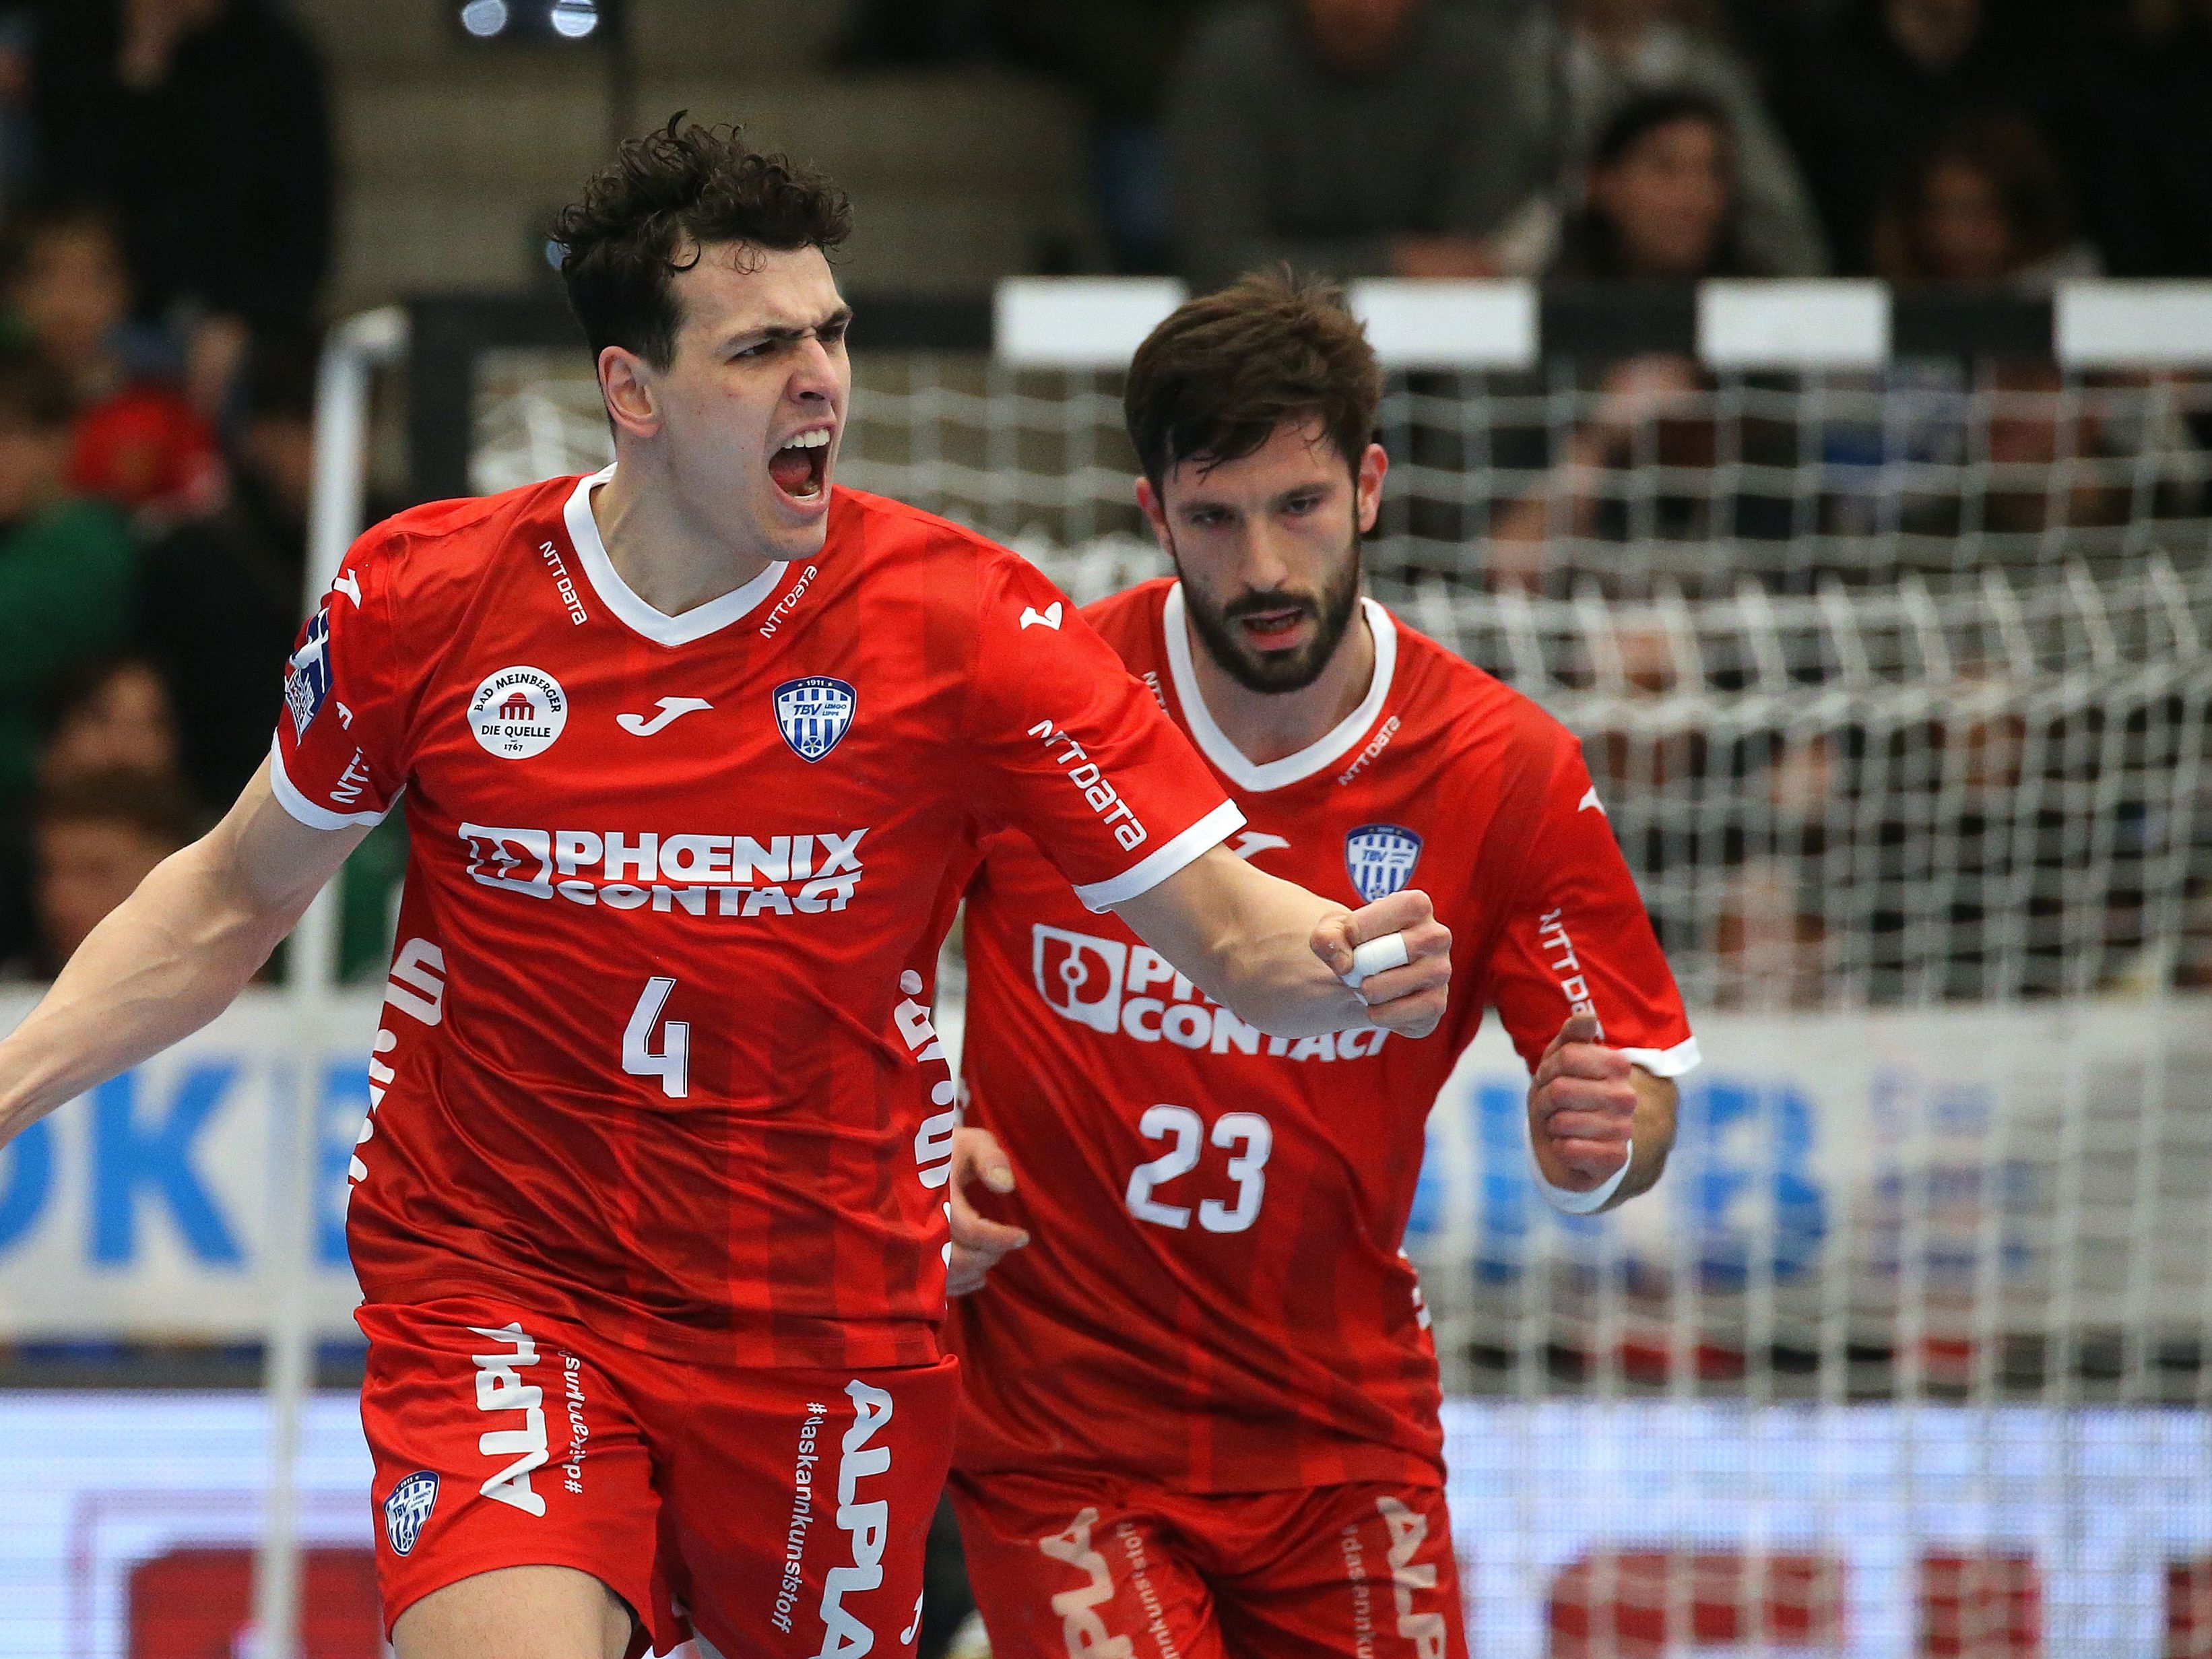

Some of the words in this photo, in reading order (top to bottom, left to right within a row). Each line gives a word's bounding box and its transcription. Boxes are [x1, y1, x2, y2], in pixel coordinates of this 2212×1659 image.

[474, 688, 494, 712] BAD
[496, 674, 562, 713] MEINBERGER
[793, 703, 822, 715] TBV
[482, 725, 500, 736] DIE
[505, 725, 551, 738] QUELLE
[504, 744, 523, 752] 1767
[556, 871, 864, 917] CONTACT
[621, 977, 690, 1099] 4
[1126, 1103, 1273, 1233] 23
[808, 1379, 893, 1659] ALPLA
